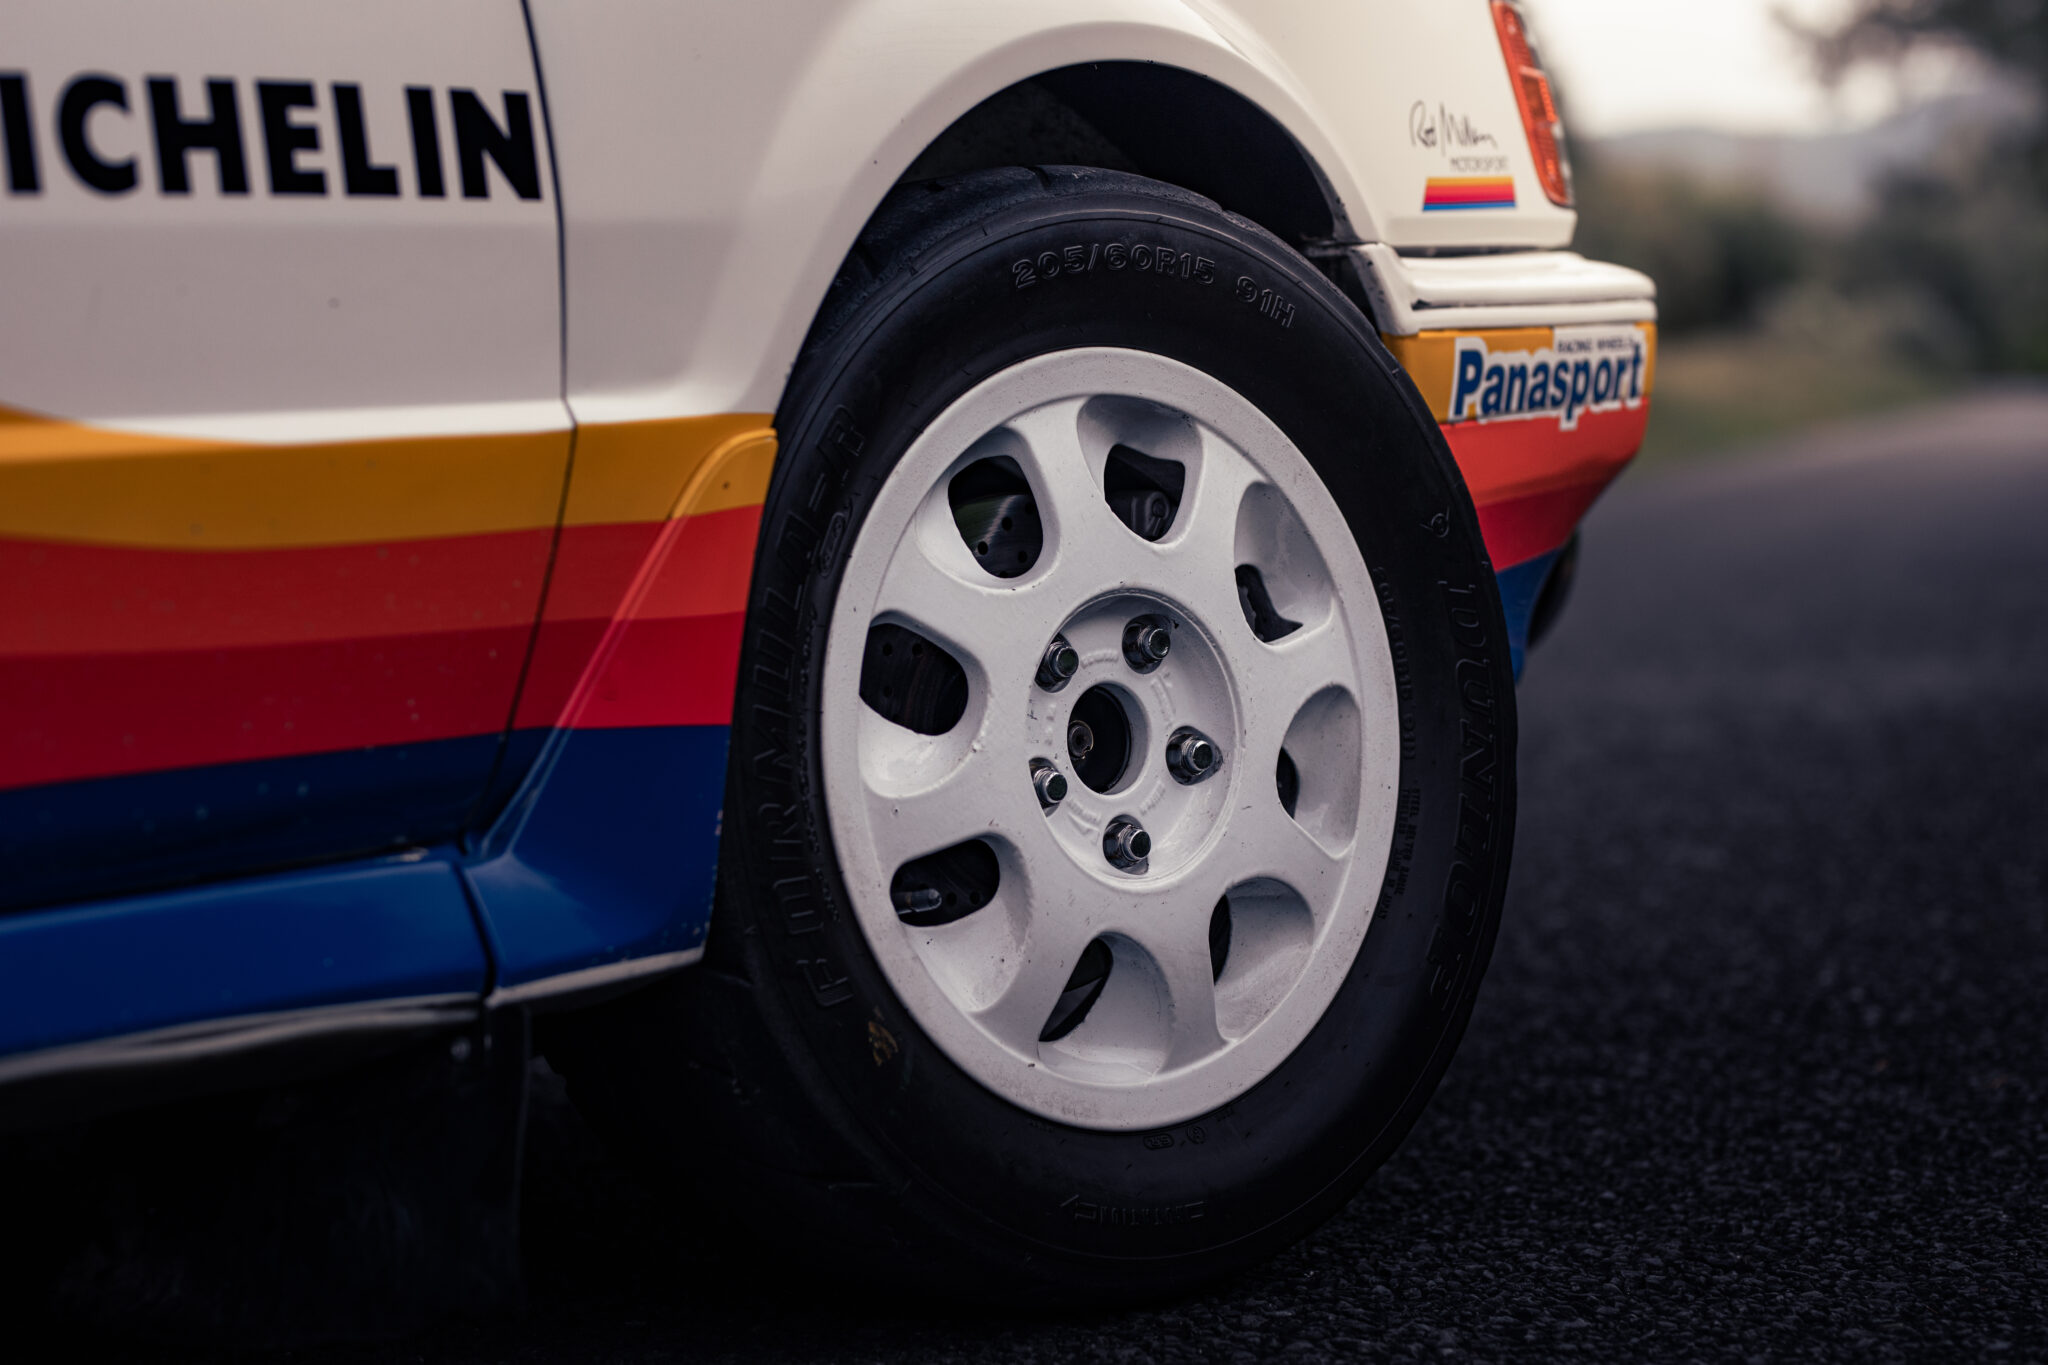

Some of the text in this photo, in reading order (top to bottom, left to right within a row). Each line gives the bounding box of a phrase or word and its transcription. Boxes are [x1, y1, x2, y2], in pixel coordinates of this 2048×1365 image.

[0, 70, 544, 201] ICHELIN
[1012, 243, 1298, 328] 205/60R15 91H
[1453, 346, 1641, 421] Panasport
